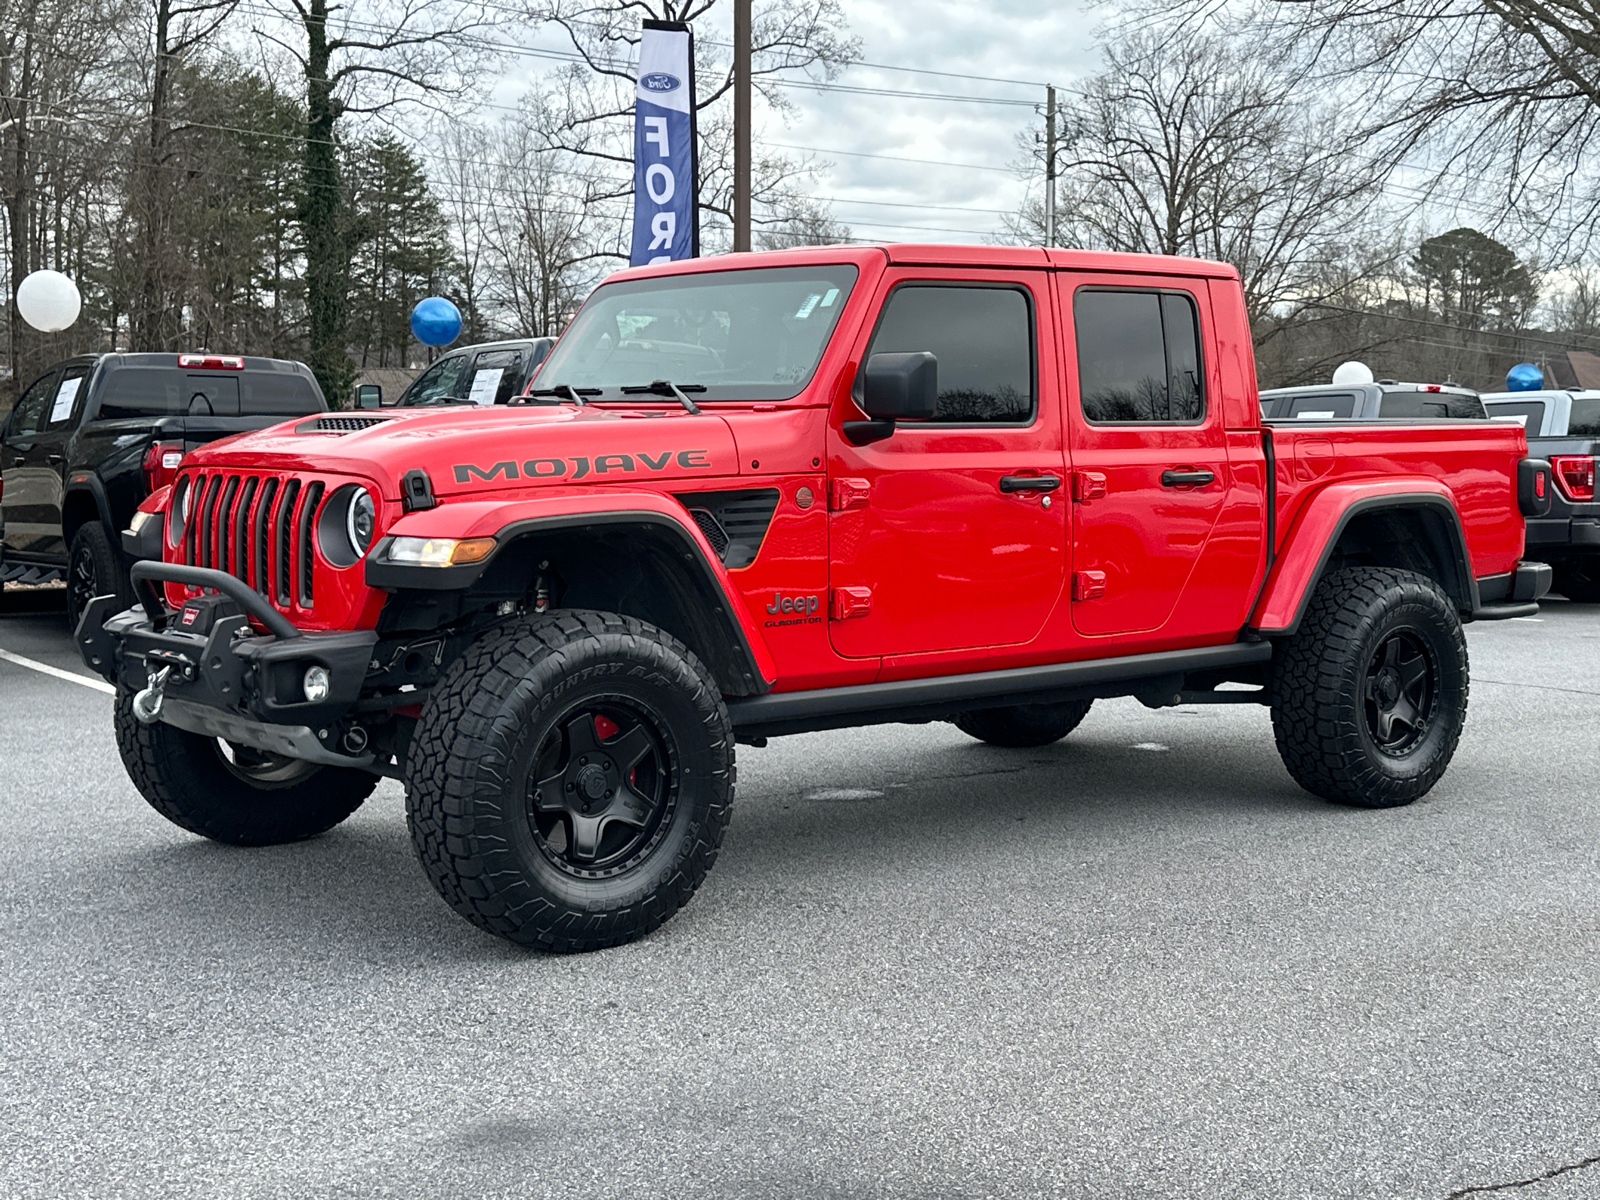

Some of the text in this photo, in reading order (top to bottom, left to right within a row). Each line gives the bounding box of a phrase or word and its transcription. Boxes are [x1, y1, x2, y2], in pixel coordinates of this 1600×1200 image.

[453, 449, 711, 484] MOJAVE
[766, 592, 819, 616] Jeep
[764, 616, 822, 628] GLADIATOR
[530, 662, 625, 725] COUNTRY
